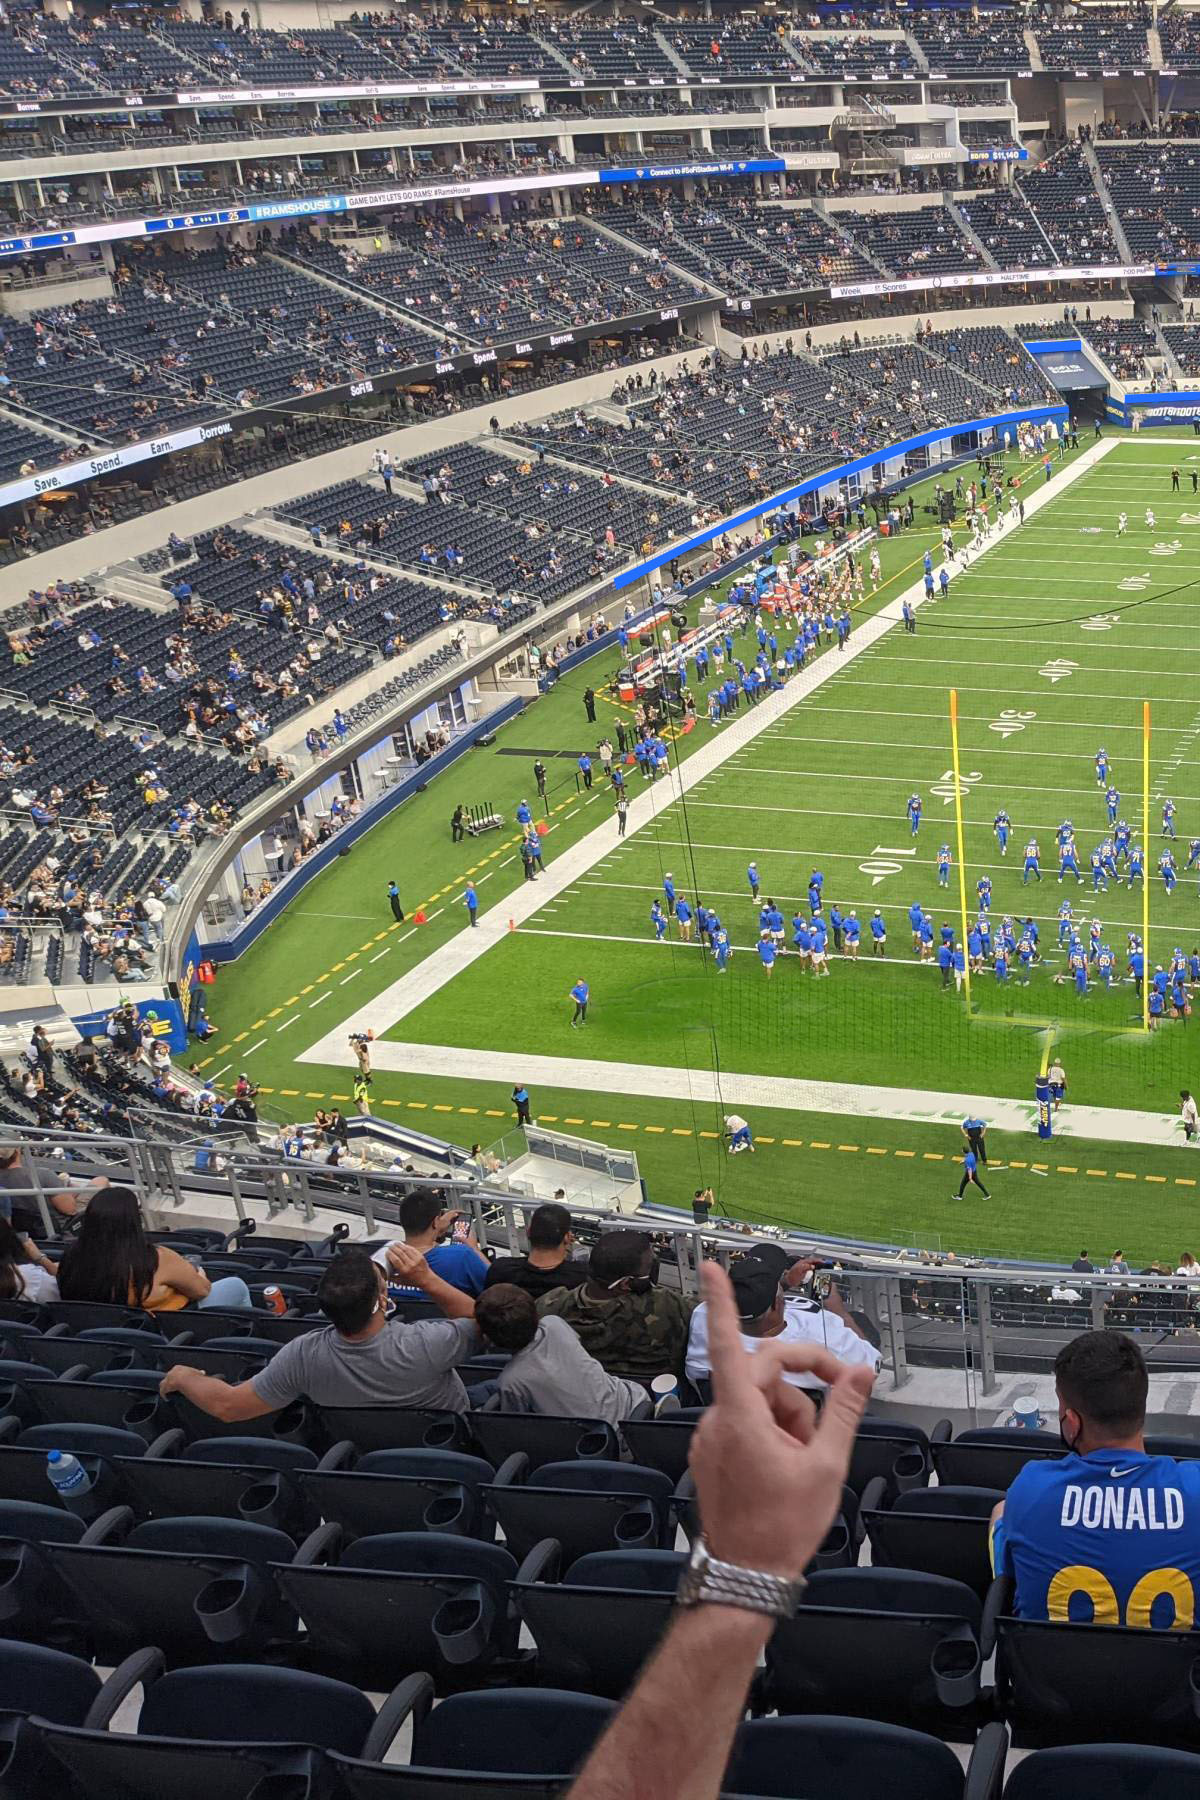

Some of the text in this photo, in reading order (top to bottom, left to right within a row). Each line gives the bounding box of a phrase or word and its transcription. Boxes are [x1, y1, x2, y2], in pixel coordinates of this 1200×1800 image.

[992, 151, 1019, 160] $11,140
[650, 168, 674, 177] Connect
[681, 165, 720, 175] #SoFiStadium
[349, 196, 369, 206] GAME
[387, 193, 402, 203] LETS
[403, 191, 413, 200] GO
[413, 190, 433, 199] RAMS!
[434, 187, 471, 197] #RamsHouse
[256, 200, 332, 217] #RAMSHOUSE
[1000, 273, 1031, 281] HALFTIME
[840, 282, 908, 296] Week Scores
[436, 333, 574, 374] Save. Spend. Earn. Borrow.
[350, 384, 366, 396] SoFi
[200, 422, 233, 440] Borrow.
[151, 441, 173, 454] Earn.
[91, 454, 123, 474] Spend.
[34, 476, 62, 492] Save.
[1080, 614, 1121, 631] 50
[1038, 658, 1080, 677] 40
[988, 709, 1037, 733] 30
[929, 770, 983, 797] 20
[858, 845, 917, 875] 10
[1061, 1485, 1184, 1530] DONALD
